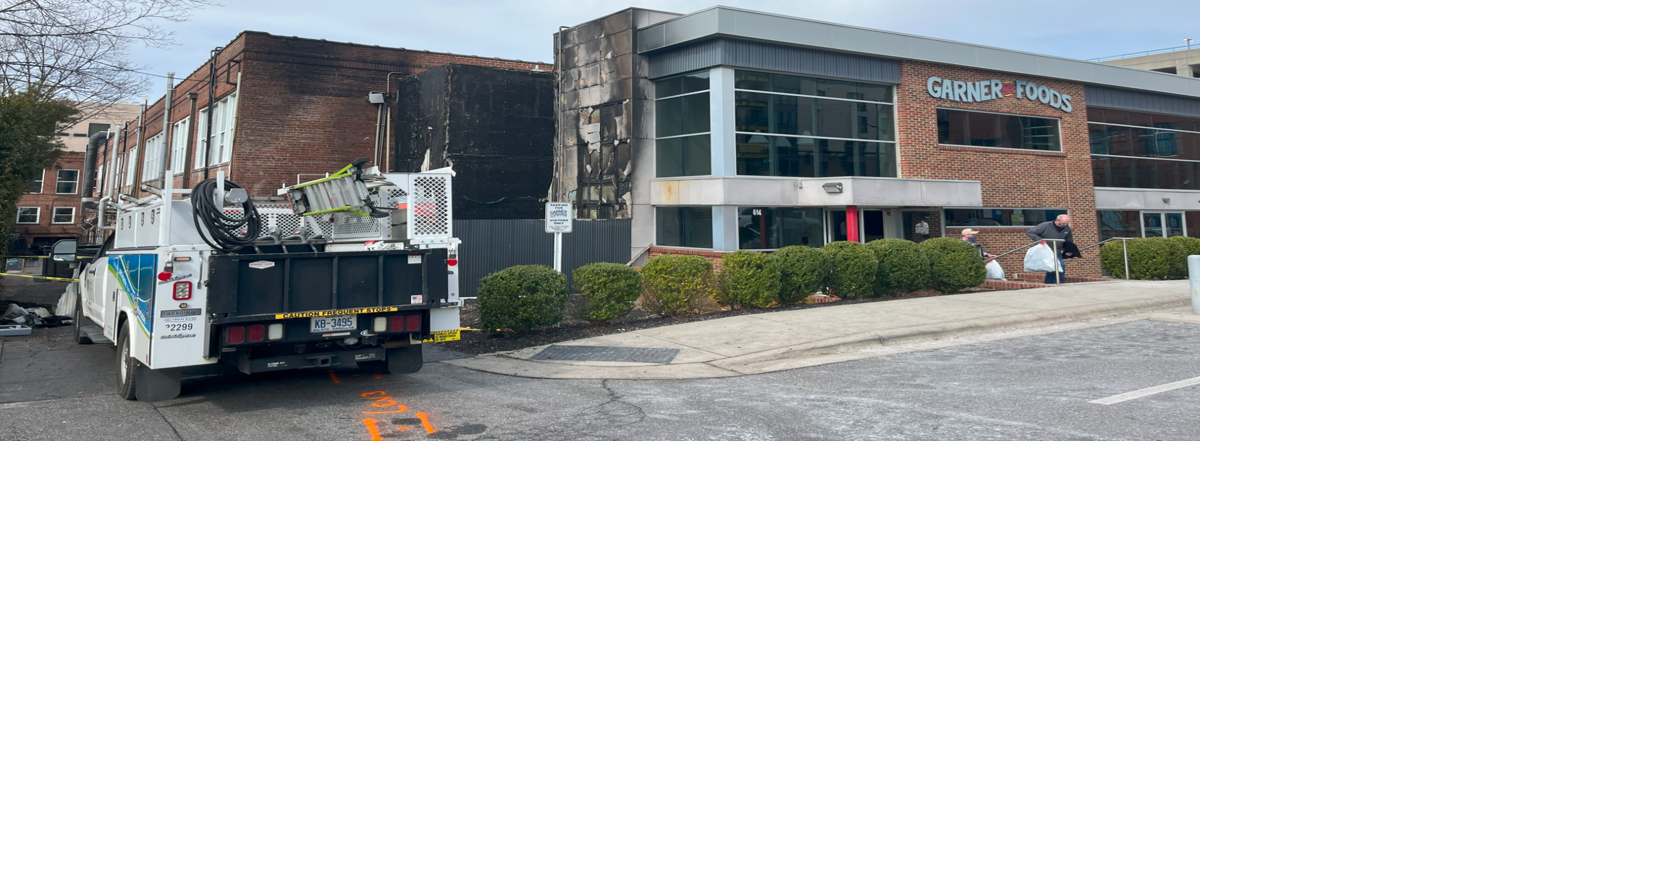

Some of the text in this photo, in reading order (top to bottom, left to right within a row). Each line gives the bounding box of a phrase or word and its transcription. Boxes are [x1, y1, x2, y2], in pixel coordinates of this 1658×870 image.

[926, 76, 1004, 103] GARNER
[1015, 80, 1073, 113] FOODS
[752, 208, 762, 216] 614
[283, 311, 320, 319] CAUTION
[322, 308, 364, 317] FREQUENT
[314, 317, 353, 329] KB-3495
